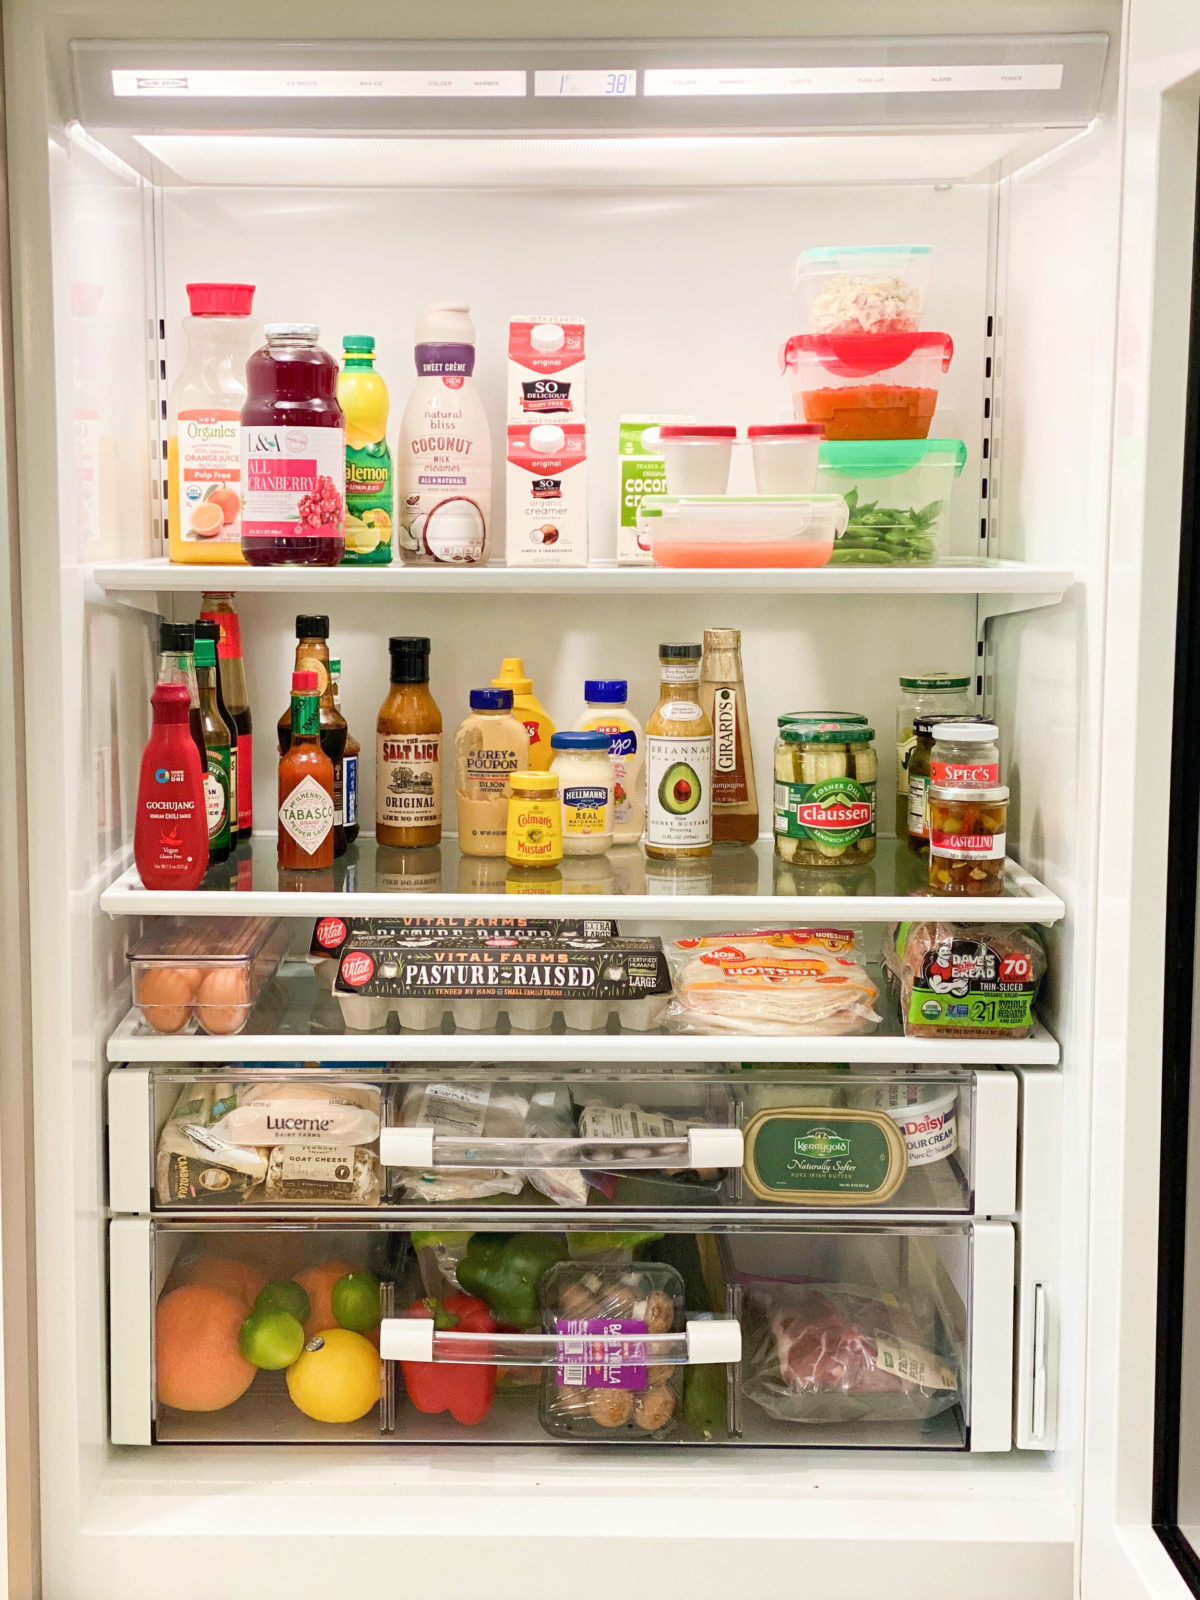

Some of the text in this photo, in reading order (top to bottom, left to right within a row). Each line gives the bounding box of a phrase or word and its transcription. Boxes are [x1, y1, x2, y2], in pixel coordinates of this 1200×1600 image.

[606, 74, 627, 94] 38
[423, 362, 466, 372] SWEET CRÈME
[535, 382, 558, 393] SO
[424, 409, 462, 419] natural
[188, 422, 236, 441] Organics
[431, 420, 456, 430] bliss
[248, 433, 281, 452] L&A
[411, 436, 473, 454] COCONUT
[249, 461, 271, 474] ALL
[345, 464, 387, 483] aLemon
[424, 464, 461, 472] creamer
[195, 472, 212, 480] Pulp
[248, 476, 315, 490] CRANBERRY
[530, 500, 562, 508] organic
[718, 702, 733, 769] GIRARD'S
[383, 743, 438, 762] SALT LICK
[478, 750, 508, 760] GREY
[652, 745, 710, 754] BRIANNAS
[466, 759, 518, 769] POUPON
[945, 765, 989, 781] SPEC'S
[567, 790, 606, 799] HELLMANN'S
[812, 784, 860, 798] KOSHER DILL
[146, 802, 194, 811] GOCHUJANG
[386, 797, 434, 808] ORIGINAL
[283, 806, 332, 820] TABASCO
[804, 806, 868, 821] claussen
[518, 814, 552, 828] Colman's
[290, 819, 328, 837] PEPPER SAUCE
[813, 830, 844, 843] SANDWICH
[950, 836, 992, 848] CASTELLINO
[518, 840, 551, 854] Mustard
[403, 918, 528, 926] VITAL FARMS
[584, 921, 611, 930] EXTRA
[318, 921, 342, 941] Vital
[816, 932, 849, 941] mission
[434, 952, 569, 962] VITAL FARMS
[952, 955, 995, 965] DAVE'S
[343, 958, 369, 979] Vital
[952, 968, 995, 978] BREAD
[1004, 960, 1026, 975] 70
[629, 976, 657, 988] LARGE
[980, 983, 1023, 991] THIN-SLICED
[998, 1000, 1027, 1009] WHOLE
[972, 1001, 995, 1022] 21
[266, 1116, 329, 1131] Lucerne
[905, 1114, 944, 1136] Daisy
[907, 1127, 953, 1150] OUR CREAM
[797, 1140, 847, 1154] Kerrygold
[787, 1159, 856, 1173] Naturally Softer
[178, 1156, 189, 1199] CAMBOZOLA
